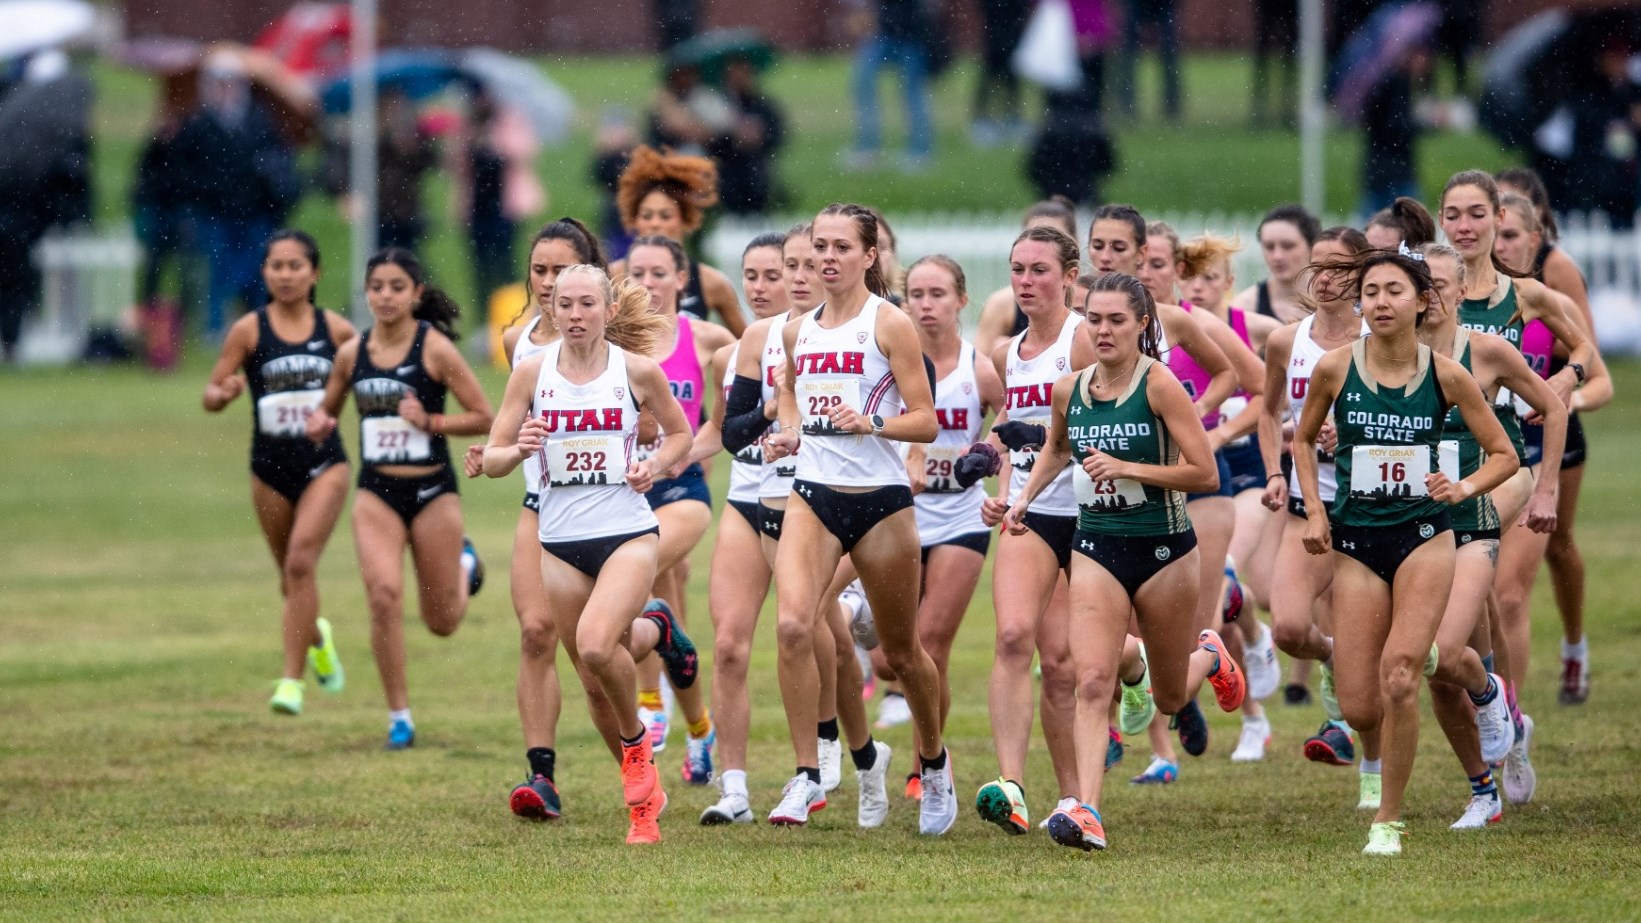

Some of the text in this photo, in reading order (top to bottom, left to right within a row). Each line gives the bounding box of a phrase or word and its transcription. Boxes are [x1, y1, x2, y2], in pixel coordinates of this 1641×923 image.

[796, 351, 865, 376] UTAH
[542, 408, 623, 433] UTAH
[1347, 411, 1433, 430] COLORADO
[377, 431, 411, 448] 227
[562, 438, 609, 447] ROY GRIAK
[1364, 426, 1415, 442] STATE
[1077, 438, 1130, 453] STATE
[1388, 449, 1416, 457] GRIAK
[566, 451, 607, 471] 232
[1378, 462, 1406, 482] 16
